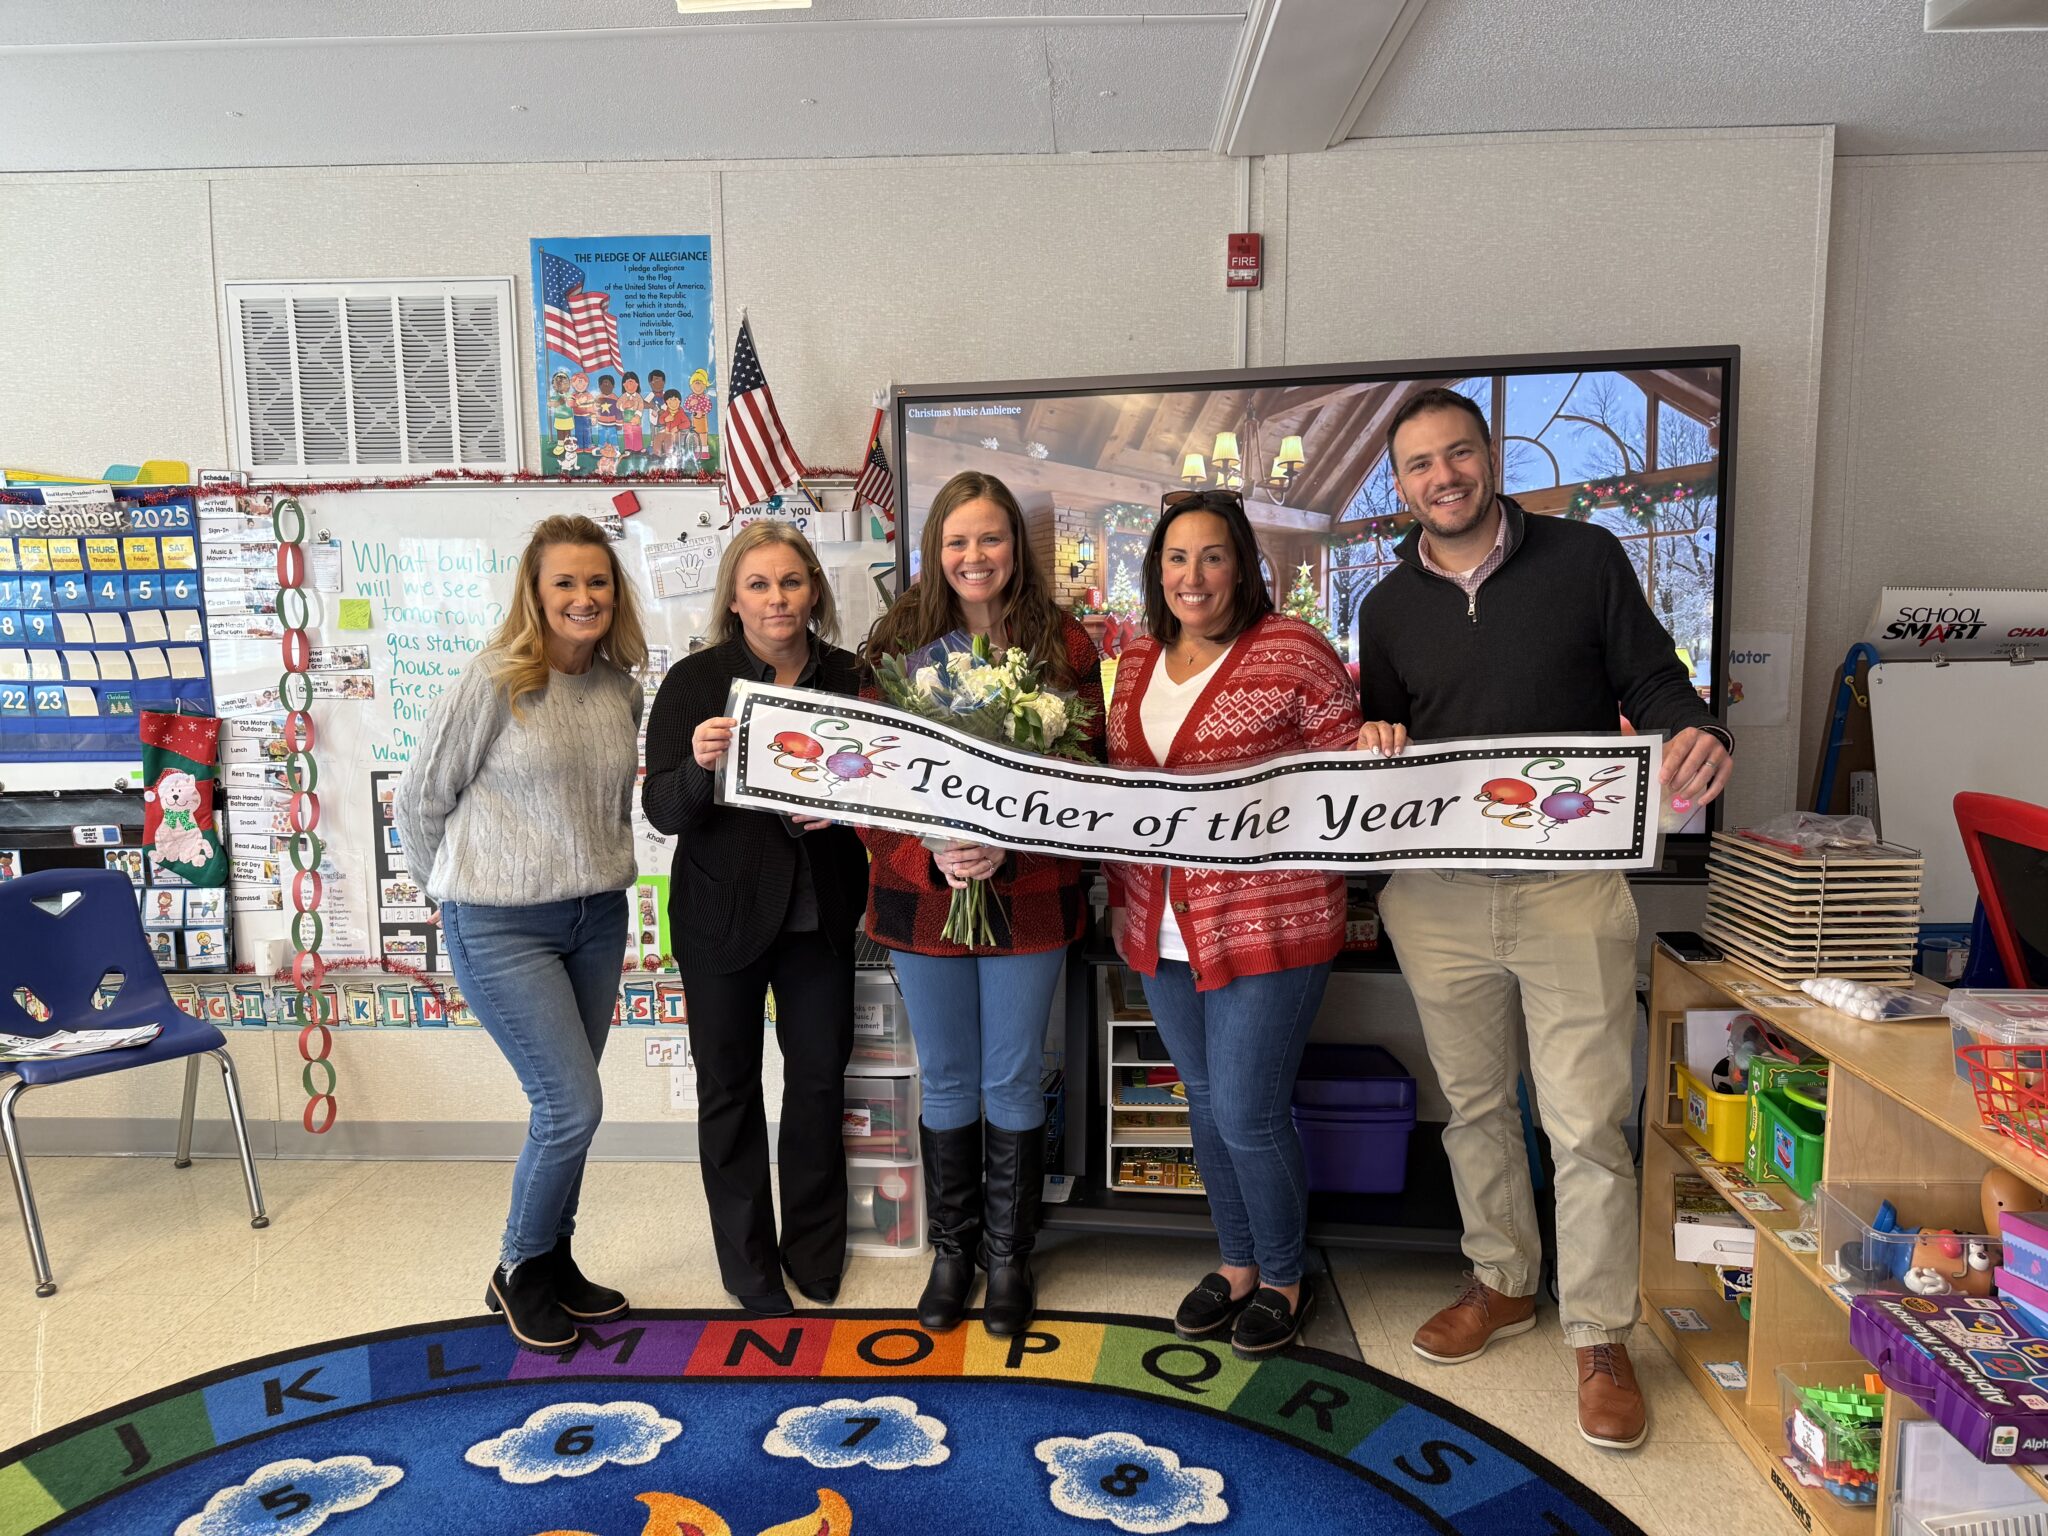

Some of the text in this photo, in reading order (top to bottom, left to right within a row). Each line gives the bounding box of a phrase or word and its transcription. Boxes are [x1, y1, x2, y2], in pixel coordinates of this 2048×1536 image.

[575, 251, 708, 262] THE PLEDGE OF ALLEGIANCE
[1232, 257, 1256, 266] FIRE
[660, 292, 686, 300] Republic
[654, 329, 675, 337] liberty
[908, 406, 1021, 418] Christmas Music Ambience
[7, 508, 190, 530] December 2025
[791, 507, 810, 517] you
[54, 546, 72, 554] WED.
[352, 540, 430, 573] What
[31, 583, 43, 601] 2
[64, 581, 78, 599] 3
[101, 581, 115, 600] 4
[139, 581, 151, 600] 5
[175, 580, 188, 598] 6
[357, 580, 482, 598] will we see
[1896, 607, 1985, 623] SCHOOL
[2, 617, 45, 635] 8 9
[1882, 623, 1987, 647] SMART
[387, 632, 420, 655] gas
[393, 653, 444, 676] house
[390, 678, 424, 698] Fire
[3, 691, 62, 710] 22 23
[906, 756, 1461, 847] Teacher of the Year
[647, 832, 666, 844] Khalil
[396, 911, 403, 920] 2
[409, 911, 415, 920] 3
[422, 910, 429, 920] 4
[208, 1000, 225, 1018] G
[250, 1001, 260, 1018] H
[356, 1000, 368, 1019] K
[391, 1000, 404, 1018] L
[424, 1000, 441, 1019] M
[634, 996, 682, 1018] S T
[1878, 1298, 1944, 1347] Memory
[1931, 1344, 2015, 1406] Alphabet
[113, 1327, 1477, 1486] J K L M N O P Q R S
[553, 1424, 596, 1456] 6
[840, 1417, 881, 1448] 7
[1100, 1463, 1149, 1498] 8
[258, 1483, 313, 1521] 5
[1771, 1467, 1812, 1530] BECKER'S
